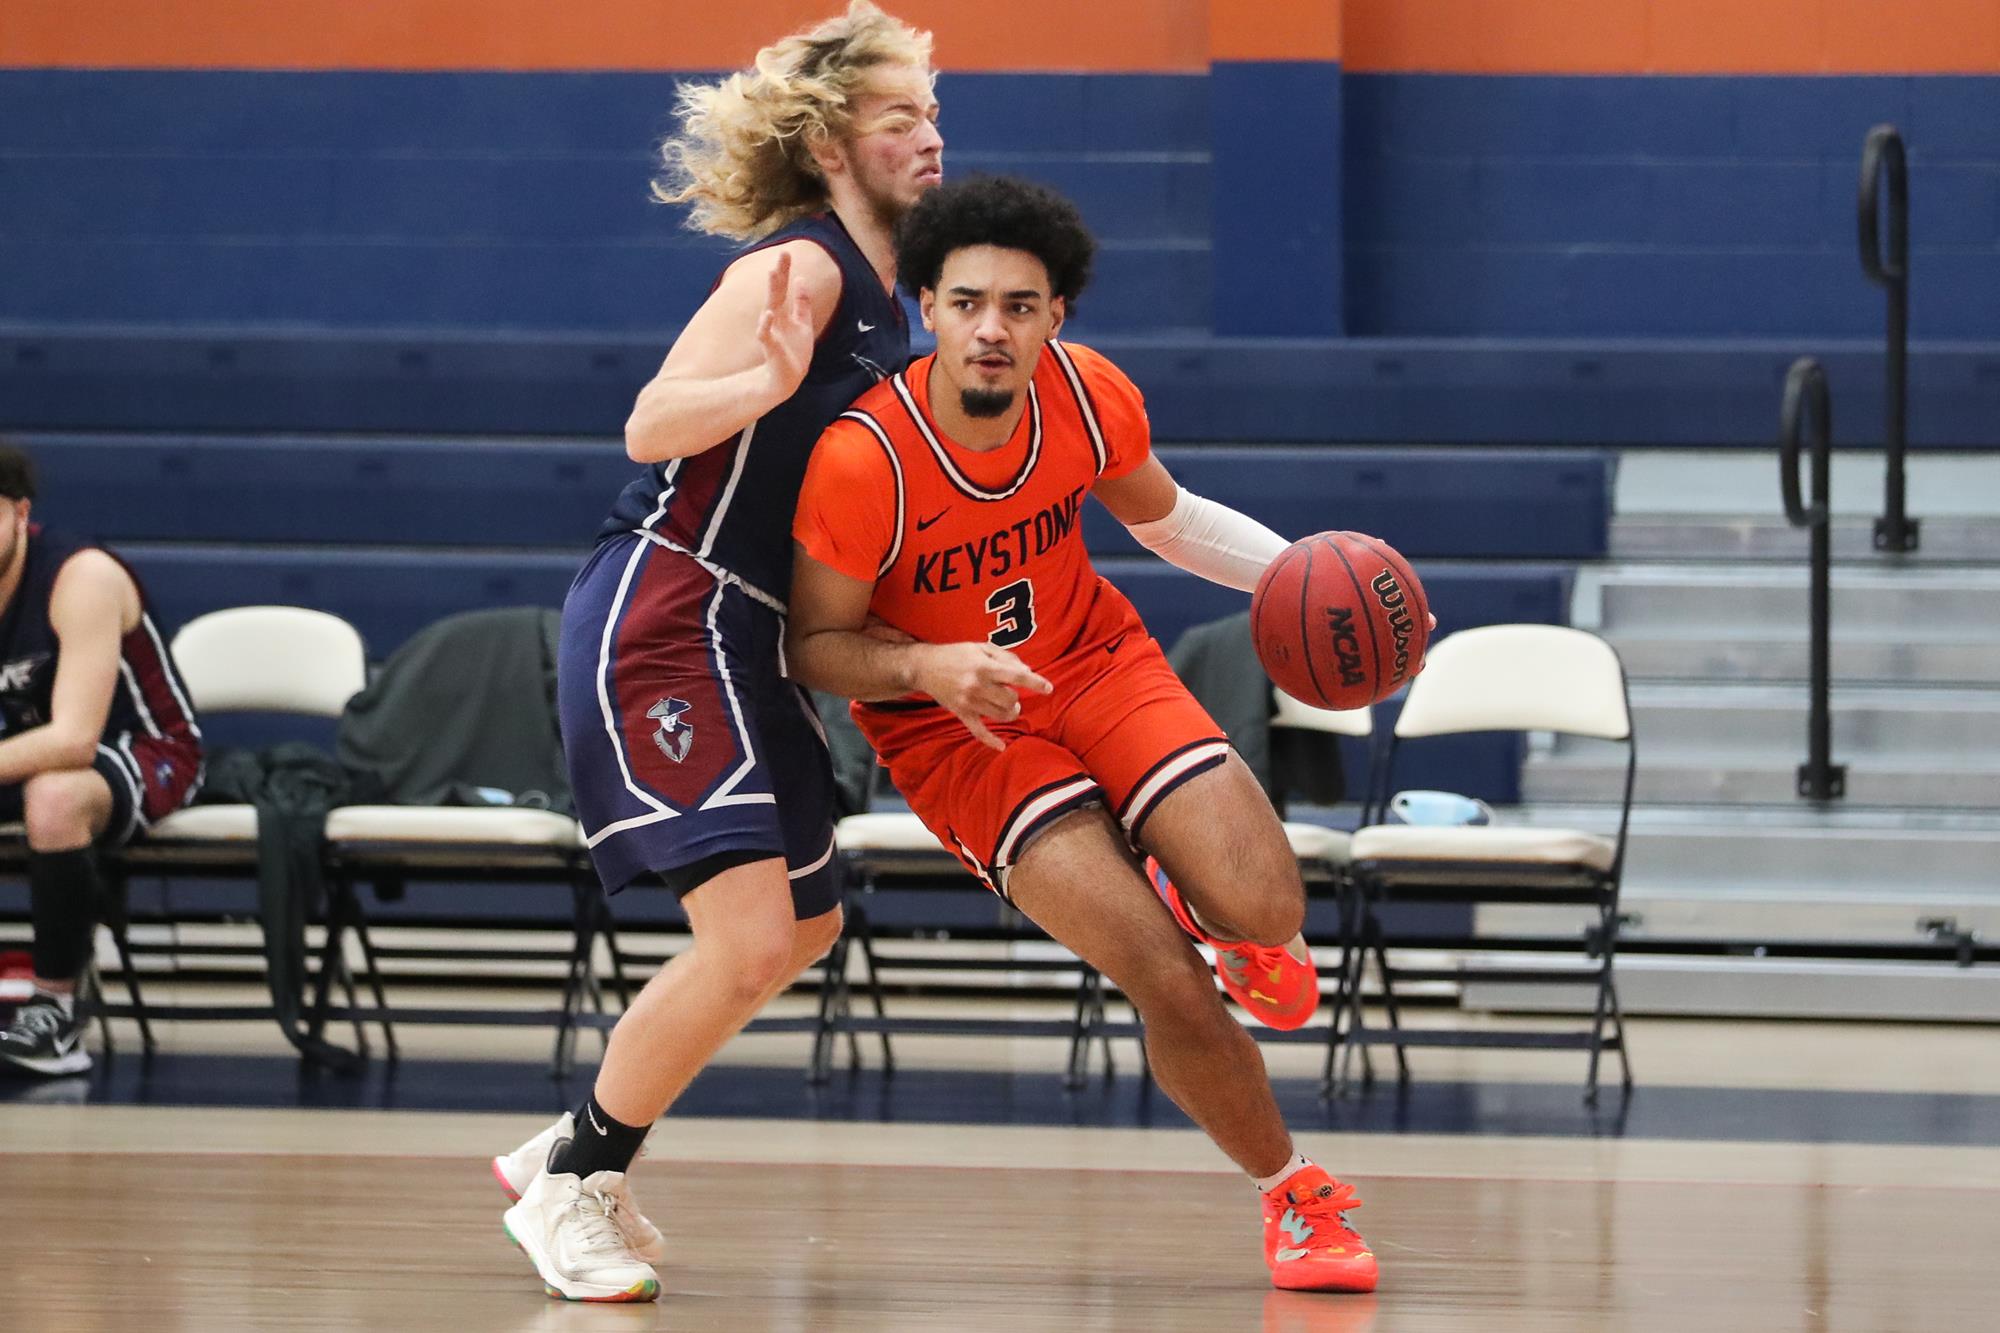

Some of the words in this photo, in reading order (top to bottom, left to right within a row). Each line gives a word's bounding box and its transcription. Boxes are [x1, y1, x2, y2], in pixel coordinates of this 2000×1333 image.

[913, 484, 1085, 594] KEYSTONE
[985, 578, 1038, 650] 3
[1326, 606, 1366, 688] NCAA
[1371, 568, 1414, 686] Wilson
